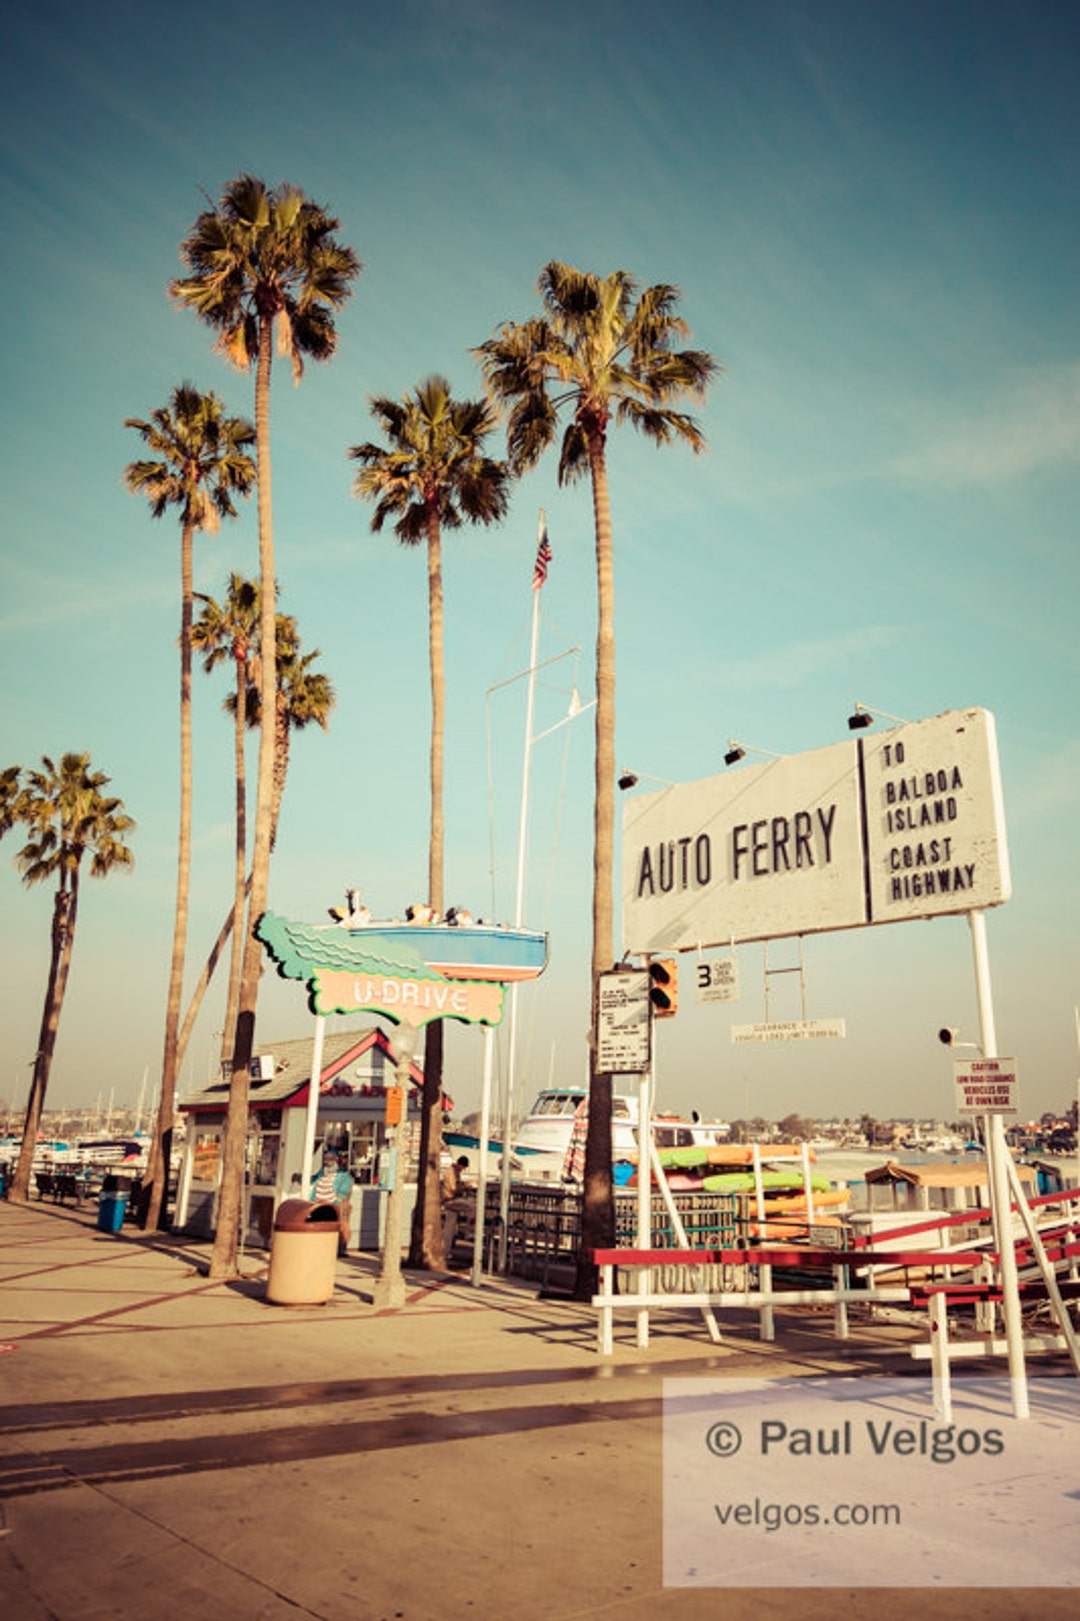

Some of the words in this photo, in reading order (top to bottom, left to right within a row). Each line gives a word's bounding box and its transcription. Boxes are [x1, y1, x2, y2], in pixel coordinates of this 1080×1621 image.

[883, 742, 905, 767] TO
[886, 766, 963, 804] BALBOA
[887, 797, 958, 833] ISLAND
[637, 833, 711, 898] AUTO
[732, 804, 836, 880] FERRY
[890, 837, 952, 870] COAST
[891, 863, 976, 900] HIGHWAY
[697, 964, 712, 988] 3
[354, 979, 470, 1012] U-DRIVE
